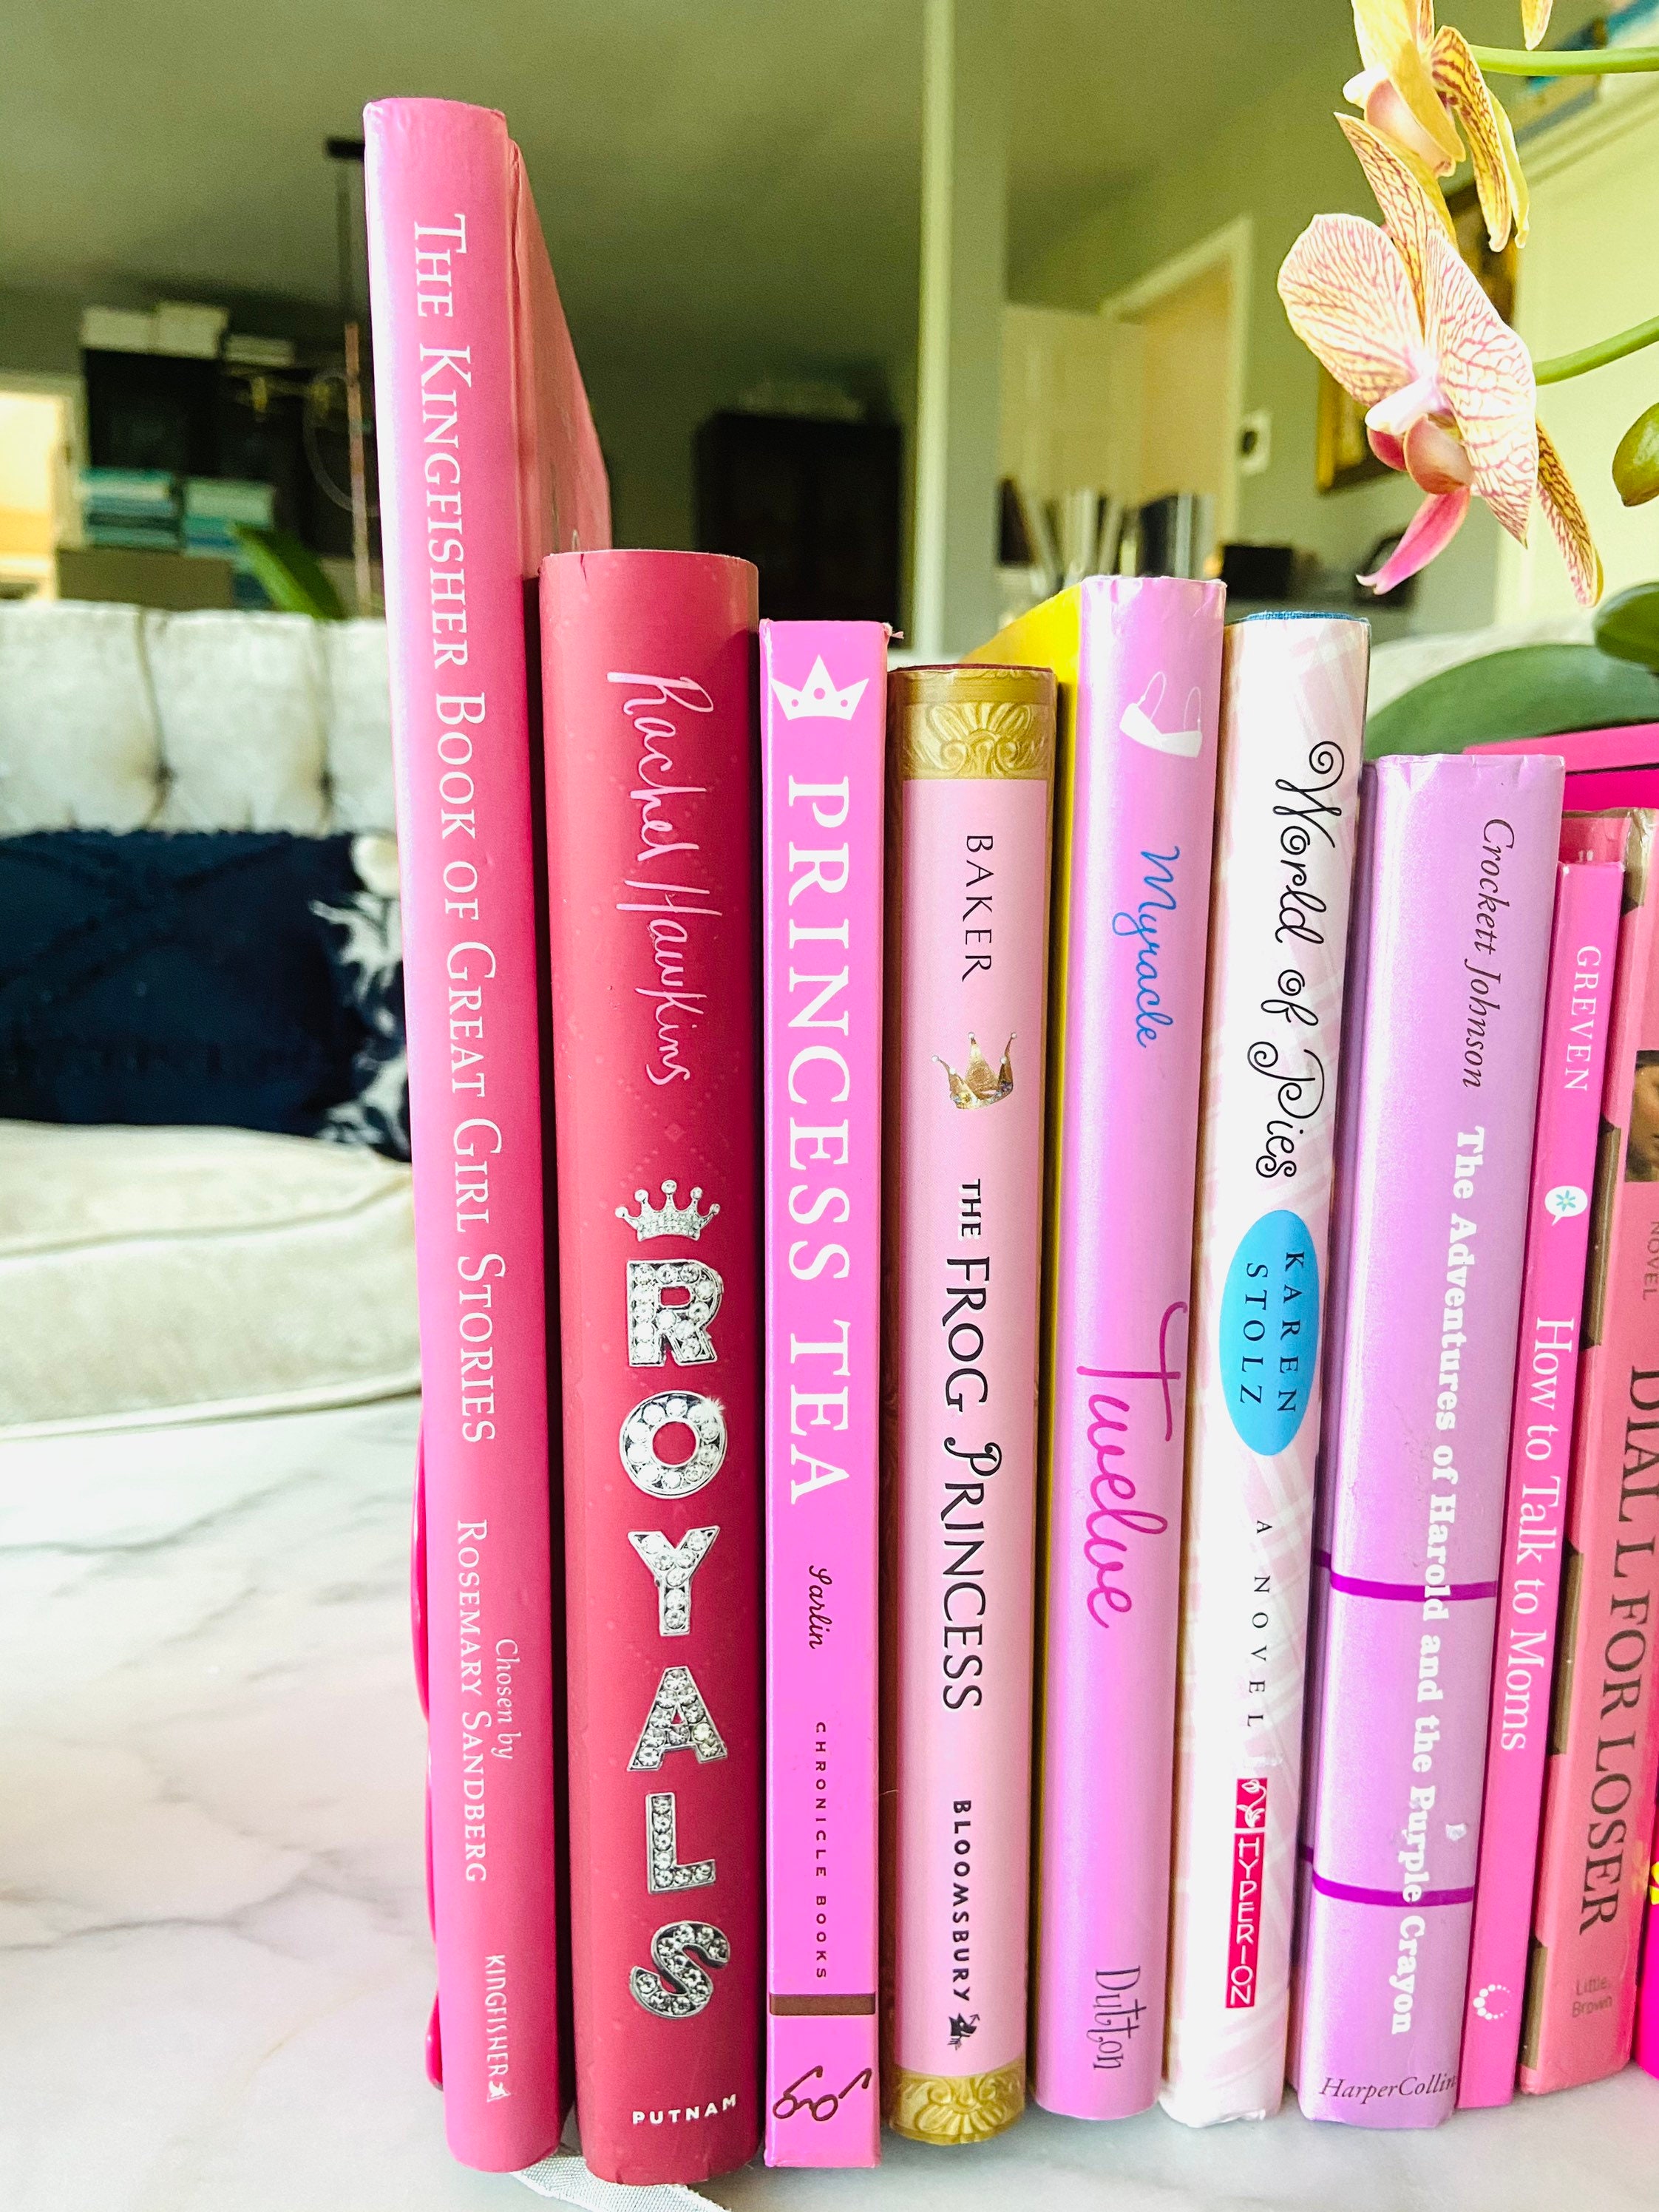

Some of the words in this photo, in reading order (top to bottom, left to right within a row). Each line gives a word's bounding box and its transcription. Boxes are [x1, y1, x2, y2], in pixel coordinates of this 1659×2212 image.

[414, 214, 467, 319] THE
[419, 343, 472, 669] KINGFISHER
[435, 692, 486, 840] BOOK
[607, 671, 714, 861] Rachel
[443, 861, 479, 920] OF
[962, 834, 994, 983] BAKER
[1272, 741, 1345, 943] World
[1474, 818, 1515, 956] Crockett
[616, 880, 723, 1086] Hawkins
[1112, 845, 1180, 1048] Myracle
[1261, 969, 1319, 1026] of
[446, 941, 497, 1098] GREAT
[787, 775, 850, 1280] PRINCESS
[1462, 958, 1502, 1088] Johnson
[1564, 945, 1601, 1091] GREVEN
[452, 1118, 503, 1232] GIRL
[1247, 1041, 1324, 1178] Pies
[1453, 1125, 1485, 1199] The
[957, 1178, 982, 1241] THE
[457, 1252, 506, 1442] STORIES
[941, 1255, 990, 1414] FROG
[1239, 1262, 1269, 1404] STOLZ
[1278, 1251, 1305, 1413] KAREN
[1435, 1212, 1478, 1431] Adventures
[1529, 1317, 1574, 1411] How
[790, 1319, 851, 1505] TEA
[1076, 1301, 1188, 1629] Twelve
[1432, 1445, 1459, 1485] of
[1525, 1423, 1559, 1461] to
[1618, 1365, 1659, 1522] DIAL
[940, 1436, 1002, 1711] PRINCESS
[1256, 1520, 1273, 1534] A
[1422, 1493, 1456, 1621] Harold
[1516, 1475, 1561, 1565] Talk
[1614, 1535, 1655, 1578] L
[457, 1519, 488, 1696] ROSEMARY
[619, 1258, 731, 2020] ROYALS
[1247, 1575, 1270, 1727] NOVEL
[1512, 1578, 1545, 1615] to
[1600, 1590, 1650, 1720] FOR
[495, 1638, 520, 1724] Chosen
[1417, 1634, 1443, 1703] and
[1501, 1629, 1547, 1751] Moms
[461, 1711, 492, 1882] SANDBERG
[491, 1731, 522, 1760] by
[815, 1722, 827, 1876] CHRONICLE
[1412, 1714, 1440, 1773] the
[1397, 1785, 1436, 1904] Purple
[1578, 1730, 1637, 1936] LOSER
[816, 1896, 827, 1978] BOOKS
[952, 1799, 972, 2002] BLOOMSBURY
[1229, 1837, 1260, 2005] HYPERION
[485, 1954, 509, 2077] KINGFISHER
[1086, 1965, 1147, 2070] Dutton
[1388, 1915, 1426, 2035] Crayon
[1572, 1995, 1612, 2018] Brown
[632, 2093, 737, 2126] PUTNAM
[1318, 2073, 1457, 2105] HarperCollin
